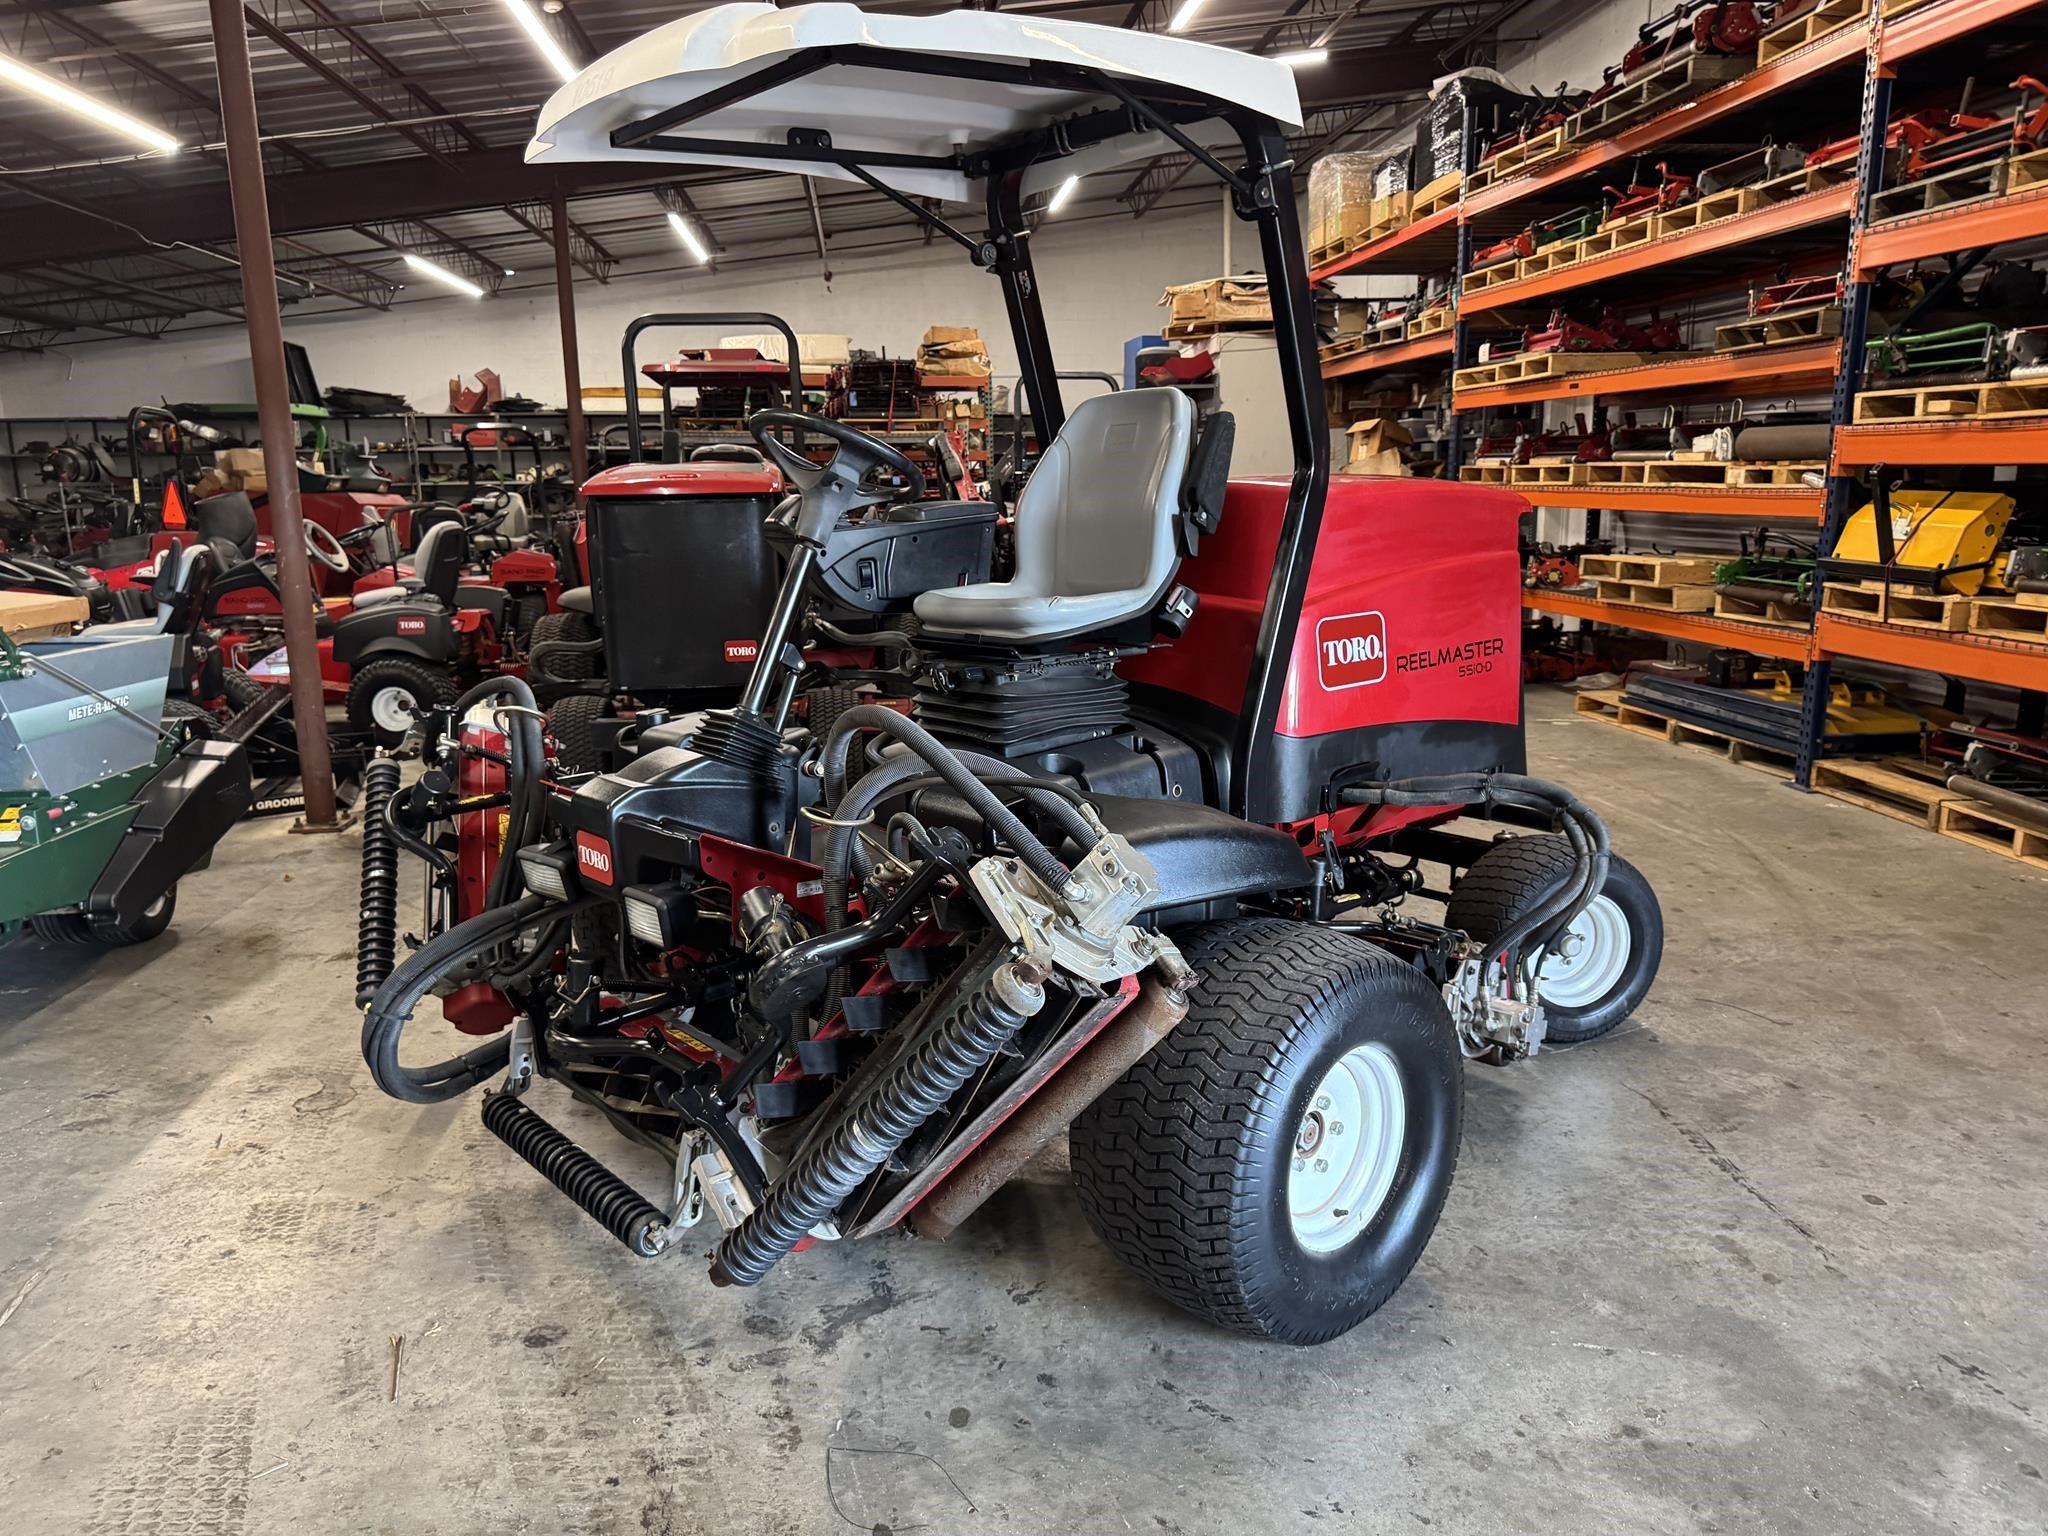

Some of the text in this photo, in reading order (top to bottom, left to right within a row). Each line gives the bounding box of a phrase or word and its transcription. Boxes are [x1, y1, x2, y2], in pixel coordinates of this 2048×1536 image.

[399, 620, 424, 630] TORO
[726, 646, 757, 657] TORO
[1323, 634, 1383, 667] TORO
[1396, 638, 1504, 674] REELMASTER
[578, 844, 609, 872] TORO
